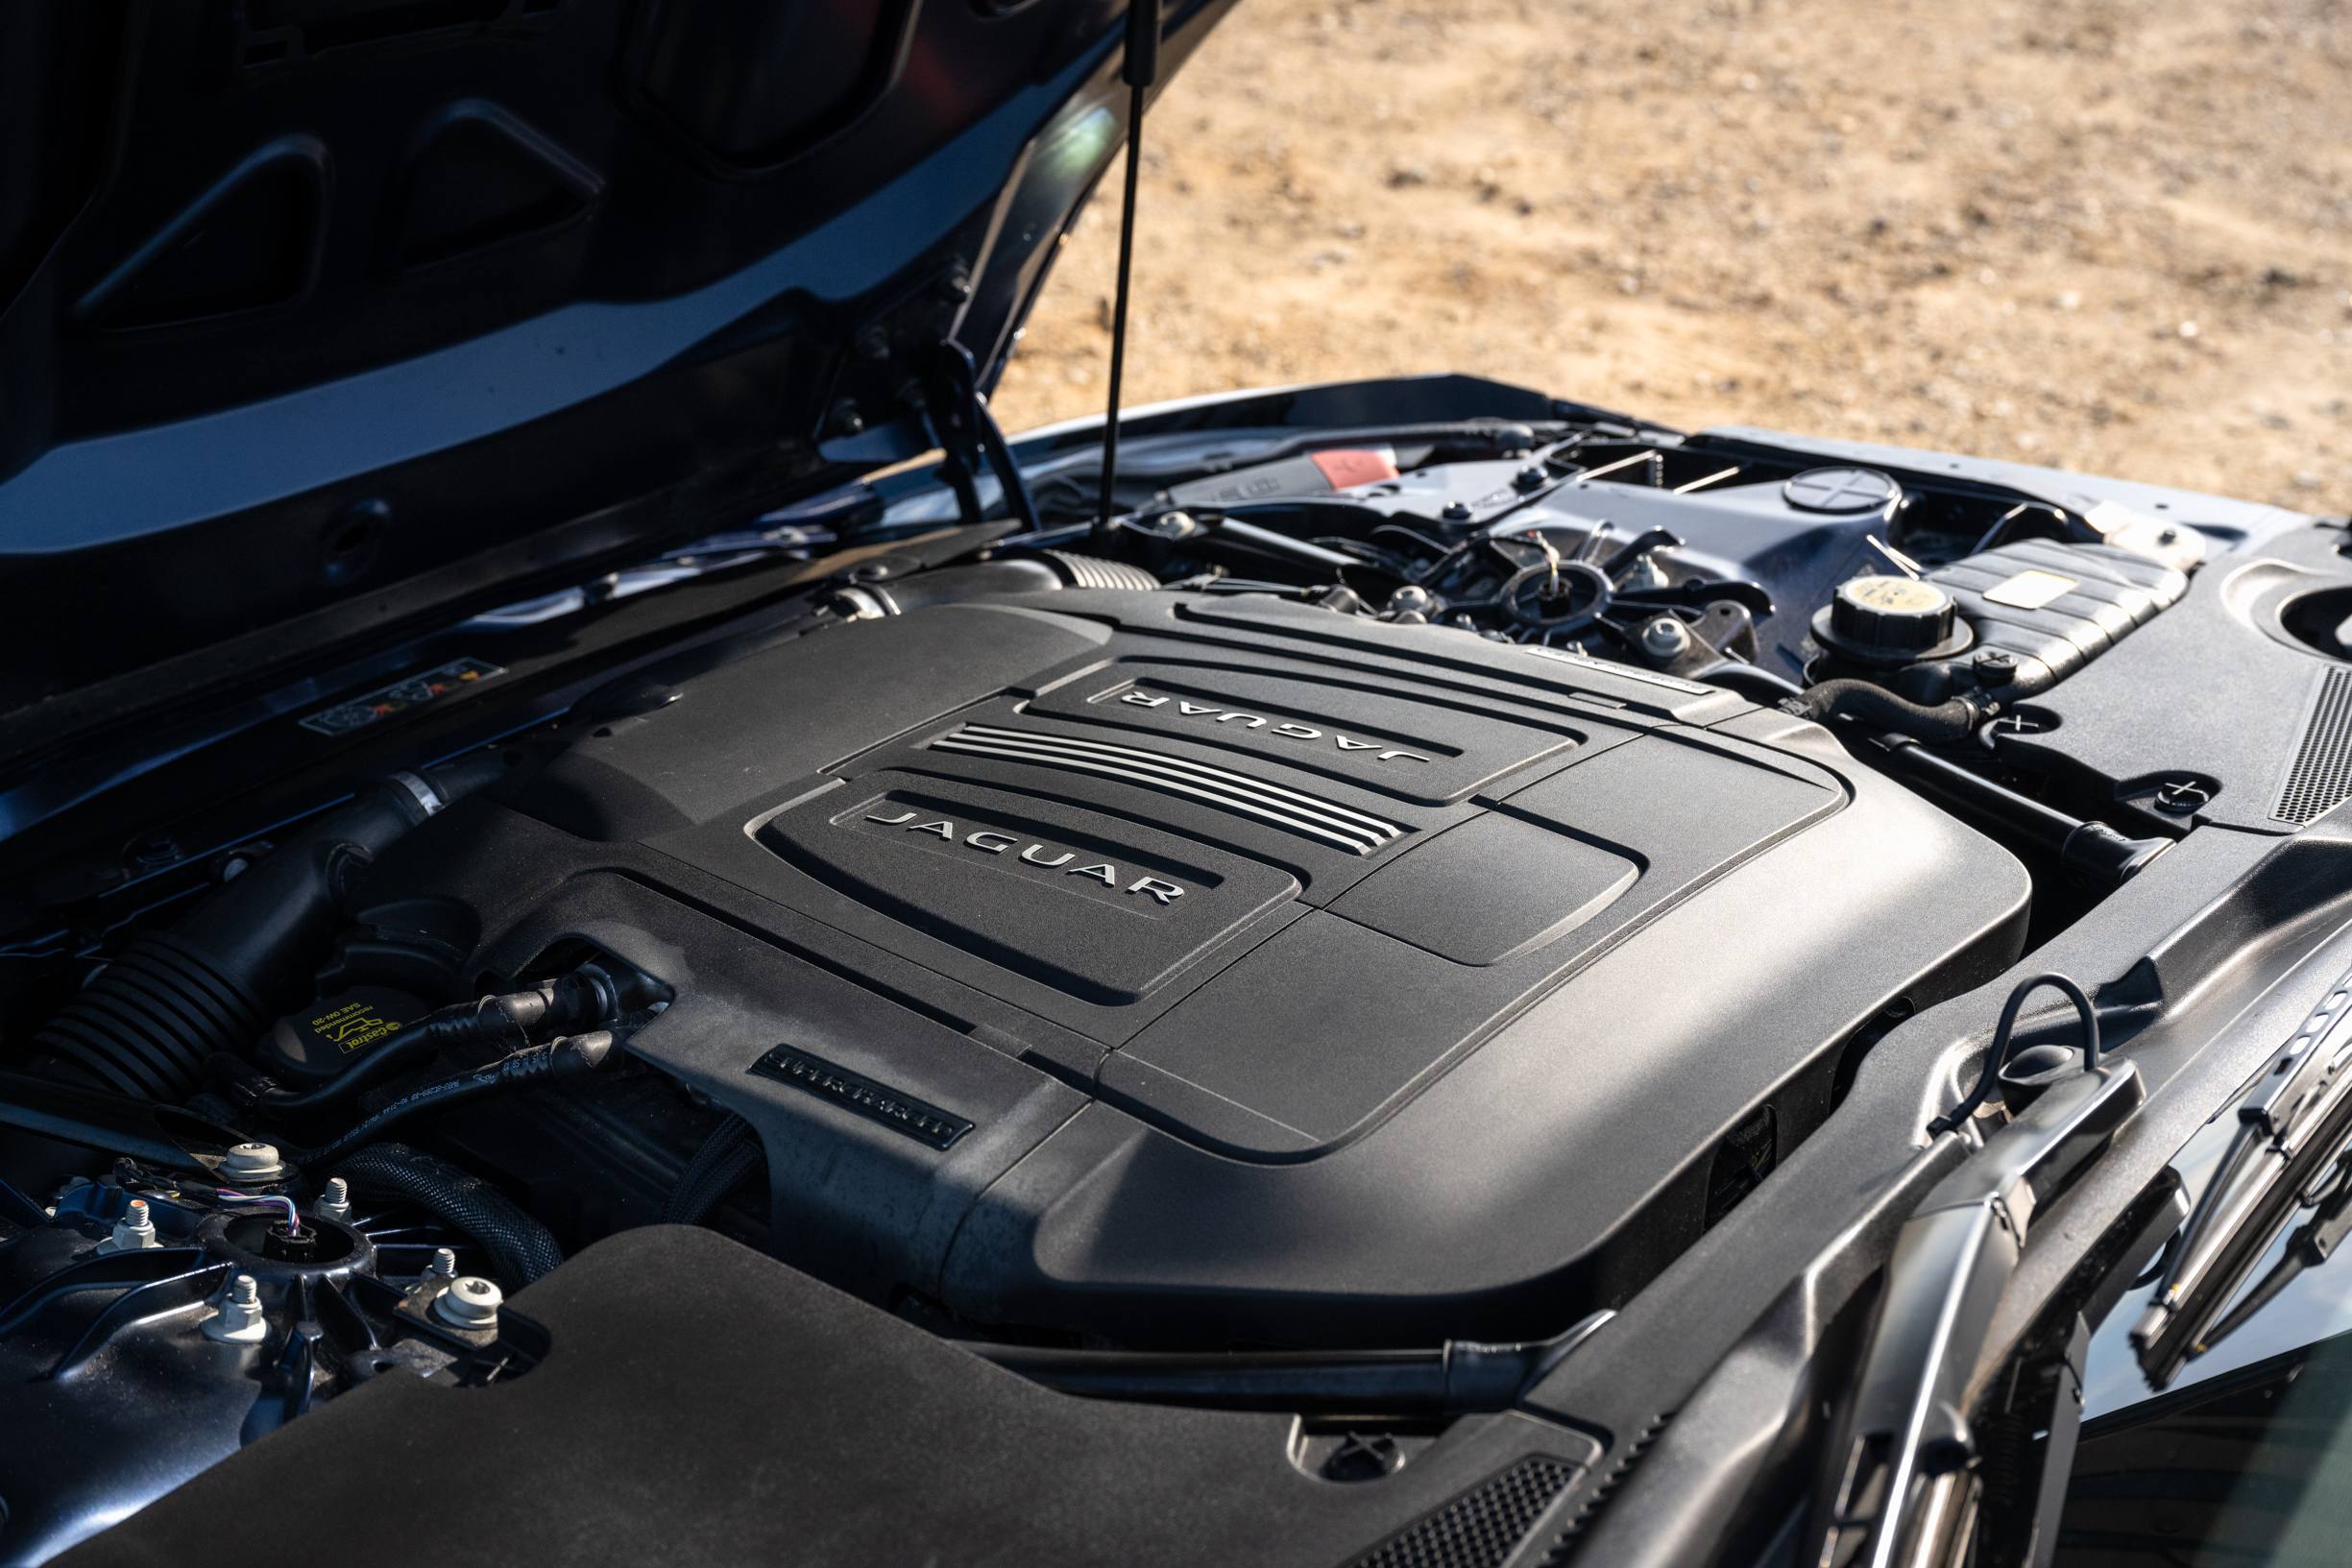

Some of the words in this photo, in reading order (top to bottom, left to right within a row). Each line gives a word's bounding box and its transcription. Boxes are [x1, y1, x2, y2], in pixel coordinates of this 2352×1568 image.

[1121, 690, 1431, 763] JAGUAR
[864, 811, 1185, 905] JAGUAR
[311, 1010, 341, 1026] 0W-20
[313, 1005, 374, 1034] recommended
[339, 1001, 361, 1014] SAE
[346, 1026, 388, 1049] Castrol
[764, 1051, 954, 1135] SUPERCHARGED
